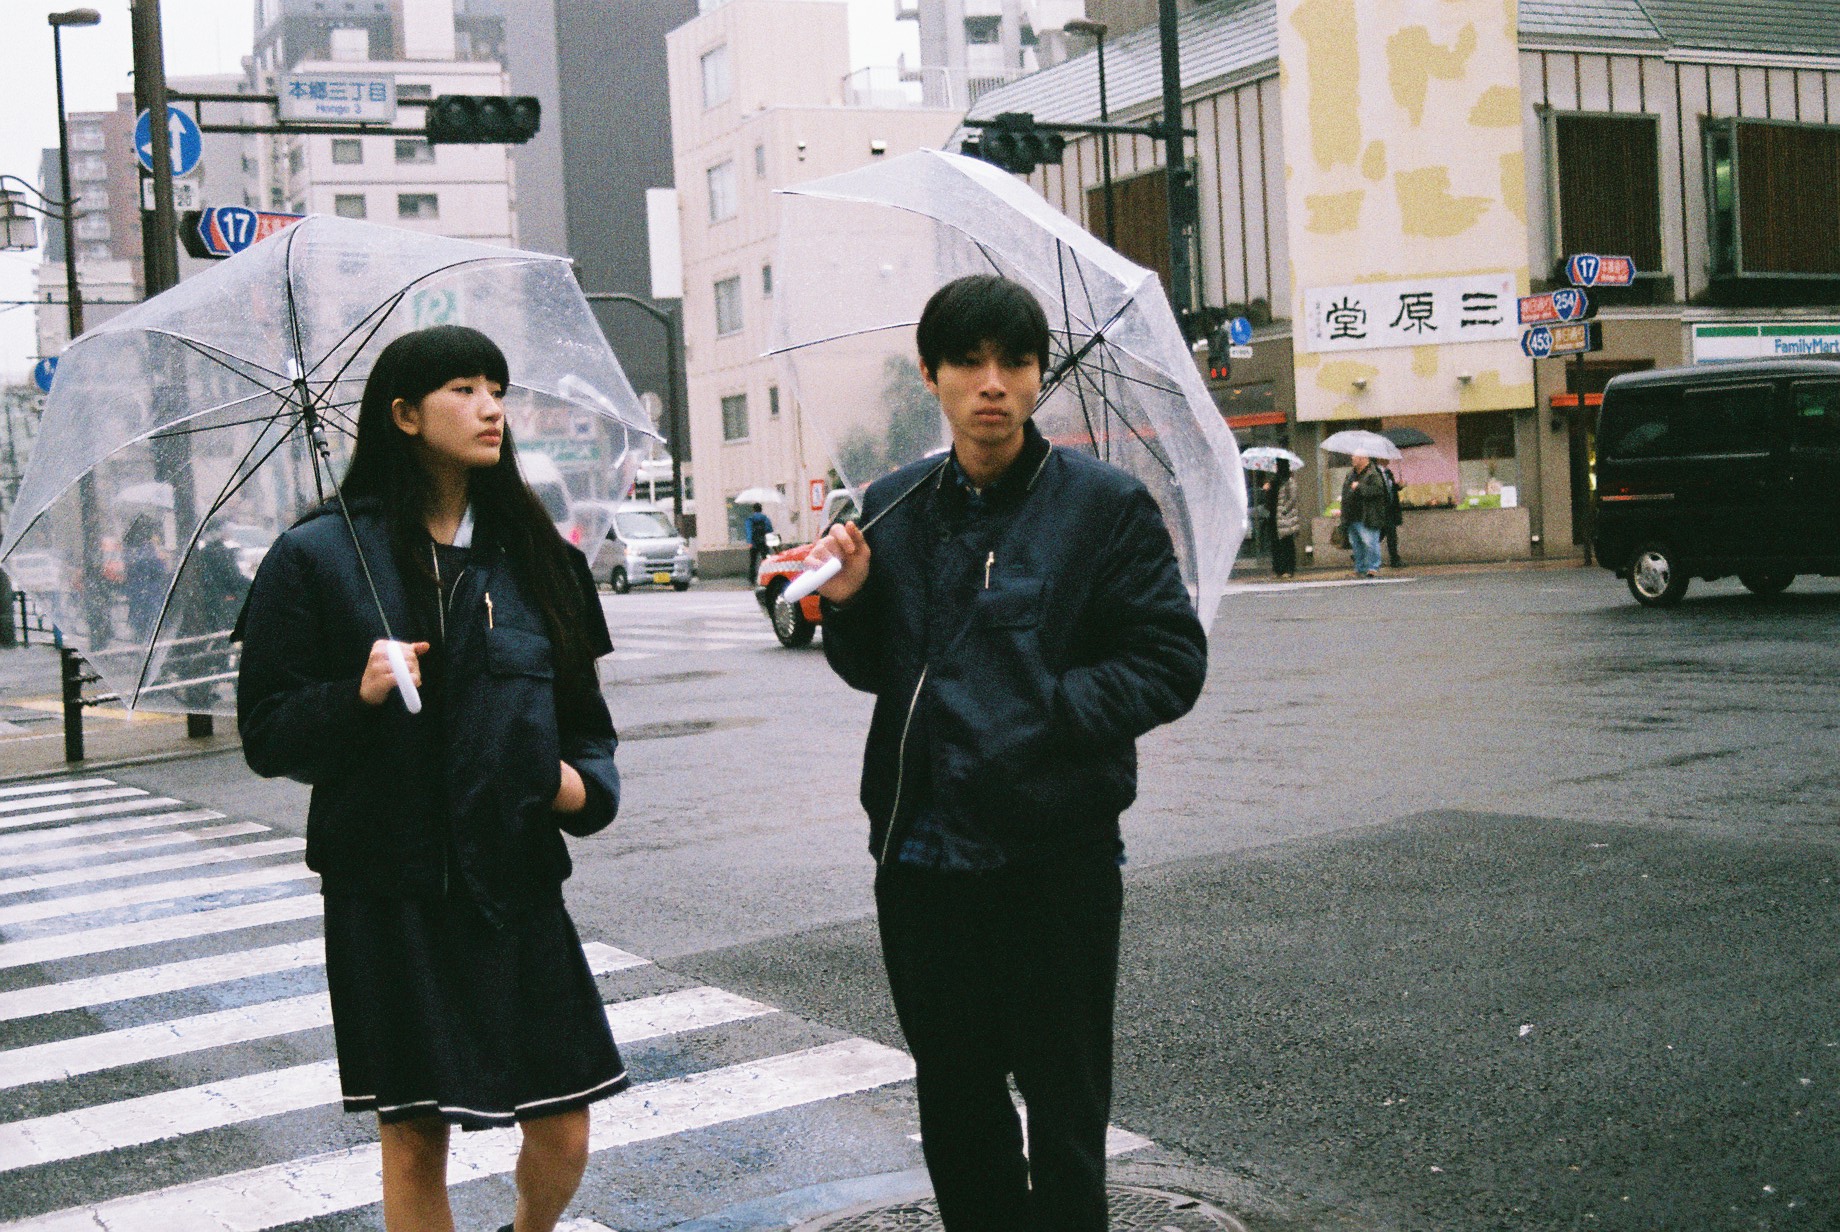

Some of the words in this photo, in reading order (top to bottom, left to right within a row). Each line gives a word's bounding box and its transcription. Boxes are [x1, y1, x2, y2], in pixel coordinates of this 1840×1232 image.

[288, 81, 387, 101] 本郷三丁目
[223, 212, 250, 243] 17
[1580, 258, 1596, 278] 17
[1555, 292, 1575, 310] 254
[1530, 333, 1552, 351] 453
[1774, 338, 1840, 354] FamilyMart
